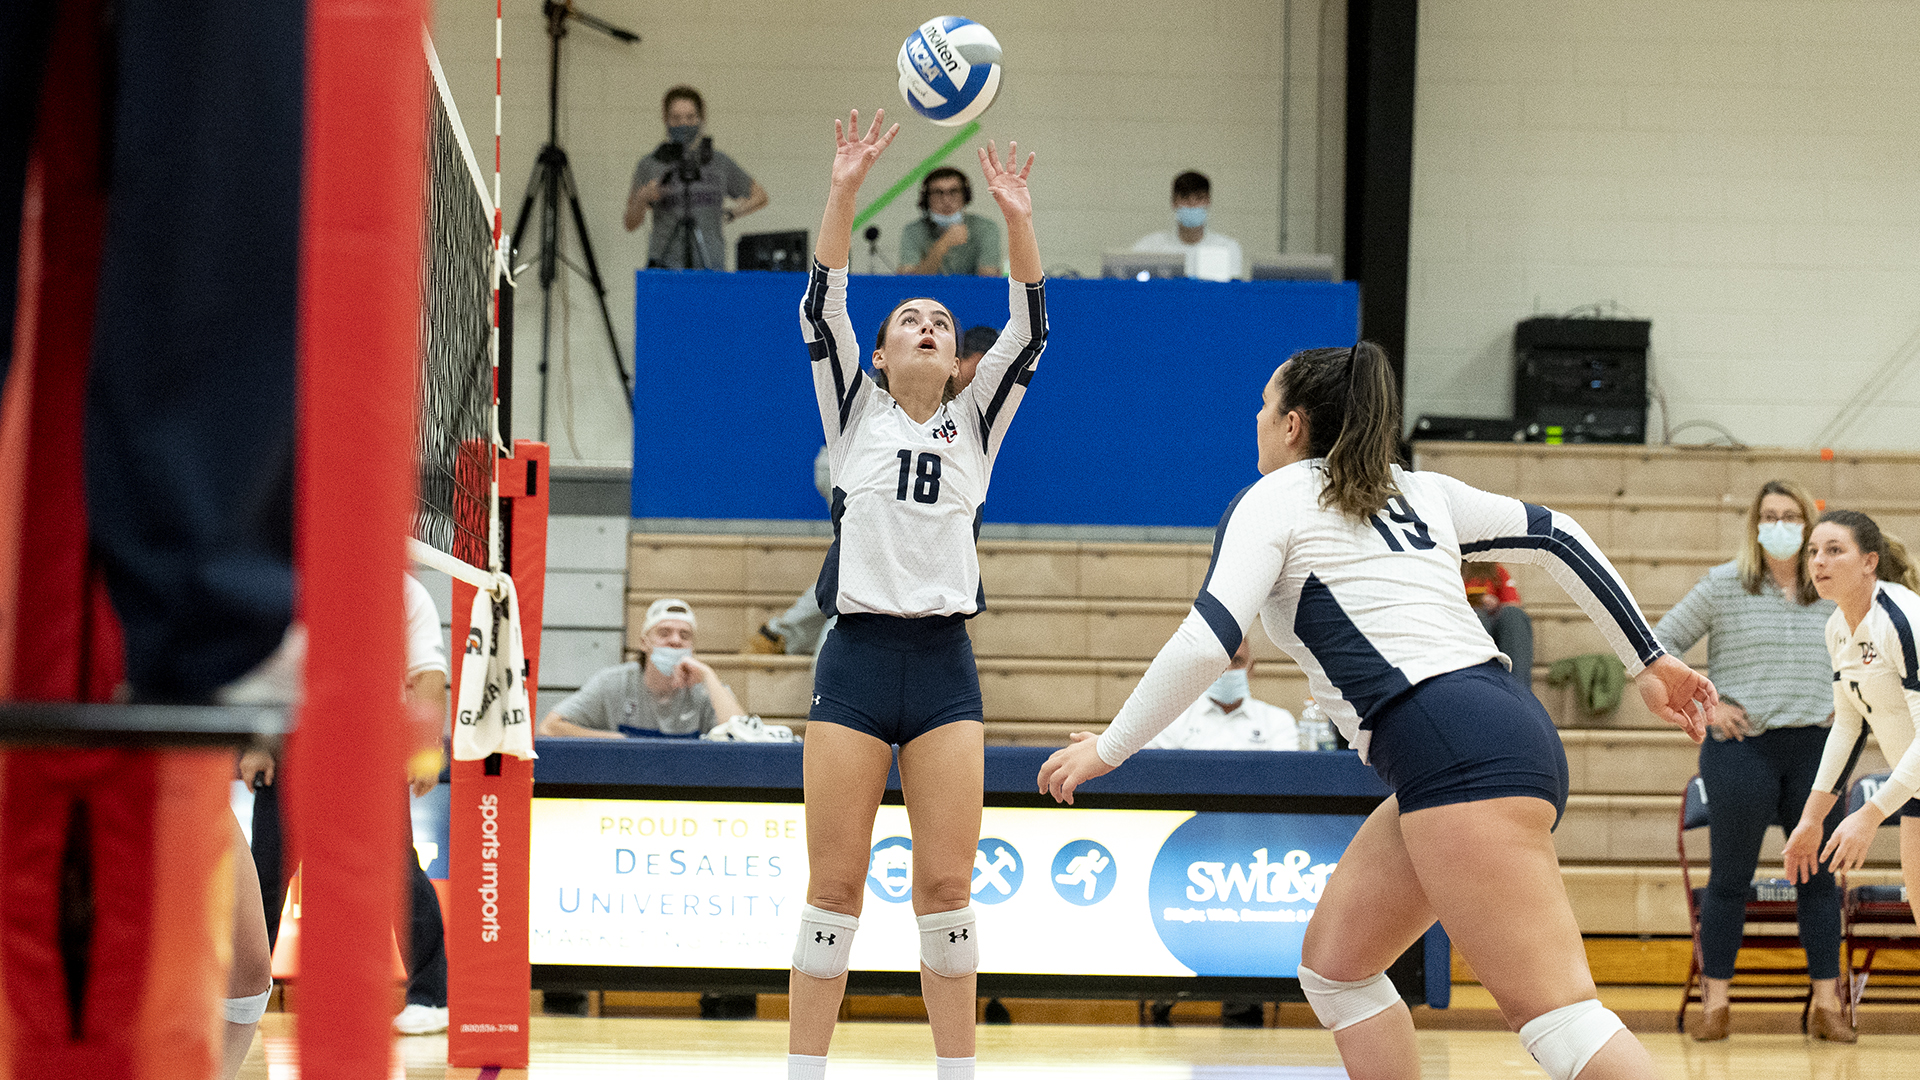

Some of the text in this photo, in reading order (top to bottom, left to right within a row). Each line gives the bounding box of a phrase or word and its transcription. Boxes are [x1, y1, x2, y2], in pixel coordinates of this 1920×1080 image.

[924, 26, 961, 73] molten
[896, 449, 942, 504] 18
[1369, 494, 1437, 552] 19
[599, 816, 798, 839] PROUD TO BE
[478, 794, 501, 943] sports imports
[559, 887, 786, 917] UNIVERSITY
